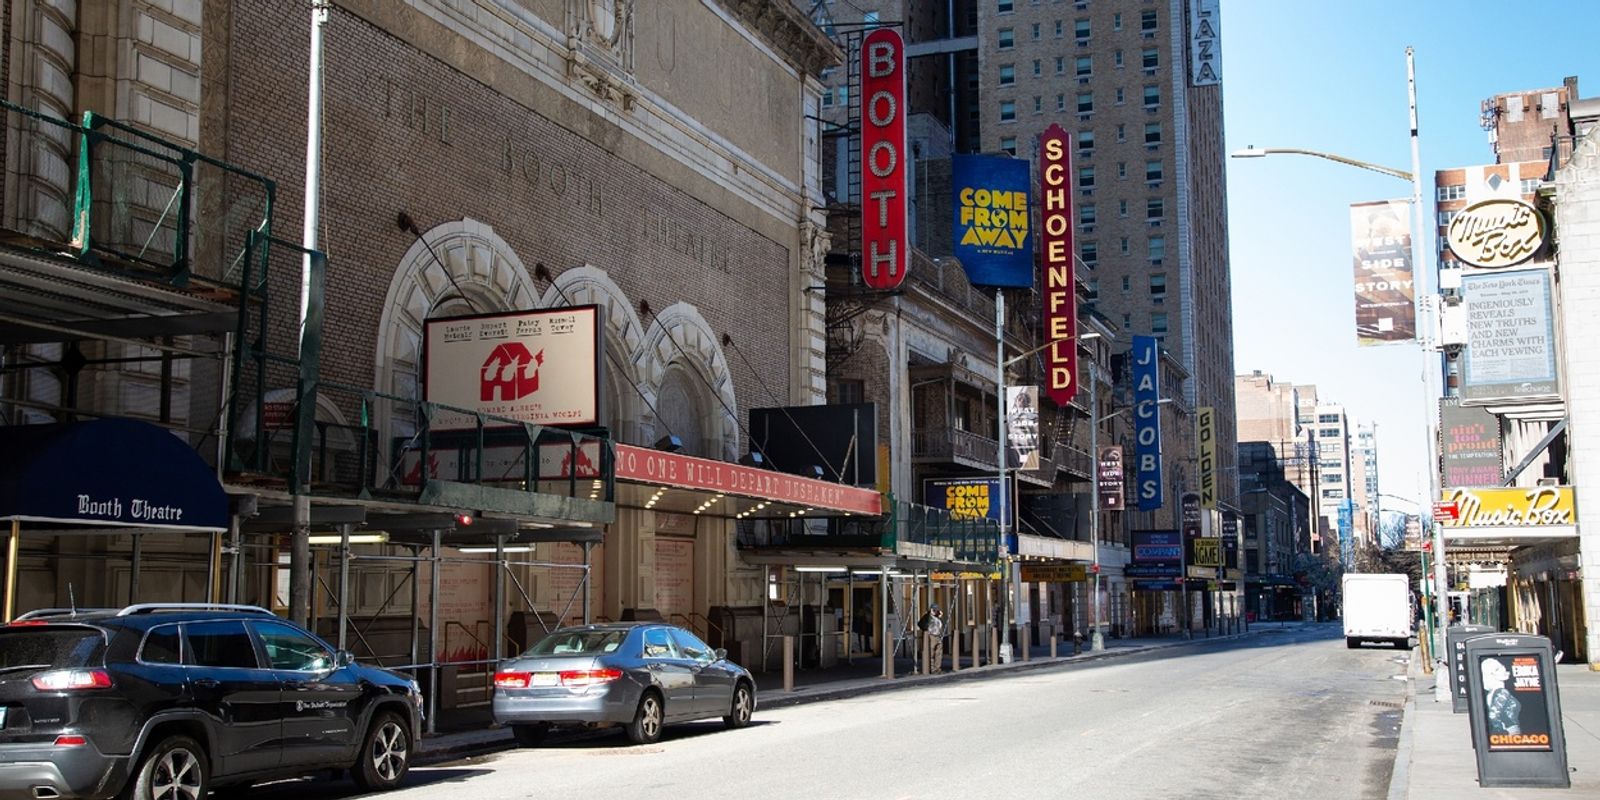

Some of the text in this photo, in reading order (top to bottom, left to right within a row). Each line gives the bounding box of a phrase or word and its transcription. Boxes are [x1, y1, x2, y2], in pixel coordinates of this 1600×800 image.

[868, 40, 898, 278] BOOTH
[501, 135, 603, 214] BOOTH
[960, 187, 1027, 210] COME
[960, 207, 1028, 229] FROM
[1453, 203, 1530, 242] Music
[960, 226, 1028, 249] AWAY
[1472, 231, 1539, 262] Box
[1045, 138, 1071, 390] SCHOENFELD
[1361, 258, 1404, 270] SIDE
[1355, 280, 1413, 292] STORY
[1468, 278, 1540, 290] The New York Times
[1469, 297, 1535, 311] INGENIOUSLY
[1470, 309, 1515, 320] REVEALS
[1470, 317, 1537, 329] NEW TRUTHS
[1472, 328, 1519, 339] AND NEW
[1472, 335, 1545, 349] CHARMS WITH
[1472, 348, 1499, 358] EACH
[1137, 347, 1157, 499] JACOBS
[1448, 438, 1497, 453] proud
[1455, 434, 1481, 443] too
[1200, 412, 1213, 505] GOLDEN
[616, 450, 636, 475] NO
[647, 455, 677, 480] ONE
[686, 462, 723, 486] WILL
[731, 470, 779, 496] DEPART
[1449, 473, 1499, 486] WINNER
[946, 485, 989, 497] COME
[77, 494, 182, 520] Booth Theatre
[946, 496, 990, 509] FROM
[1450, 486, 1521, 527] Music
[1526, 486, 1571, 525] Box
[1489, 734, 1549, 745] CHICAGO
